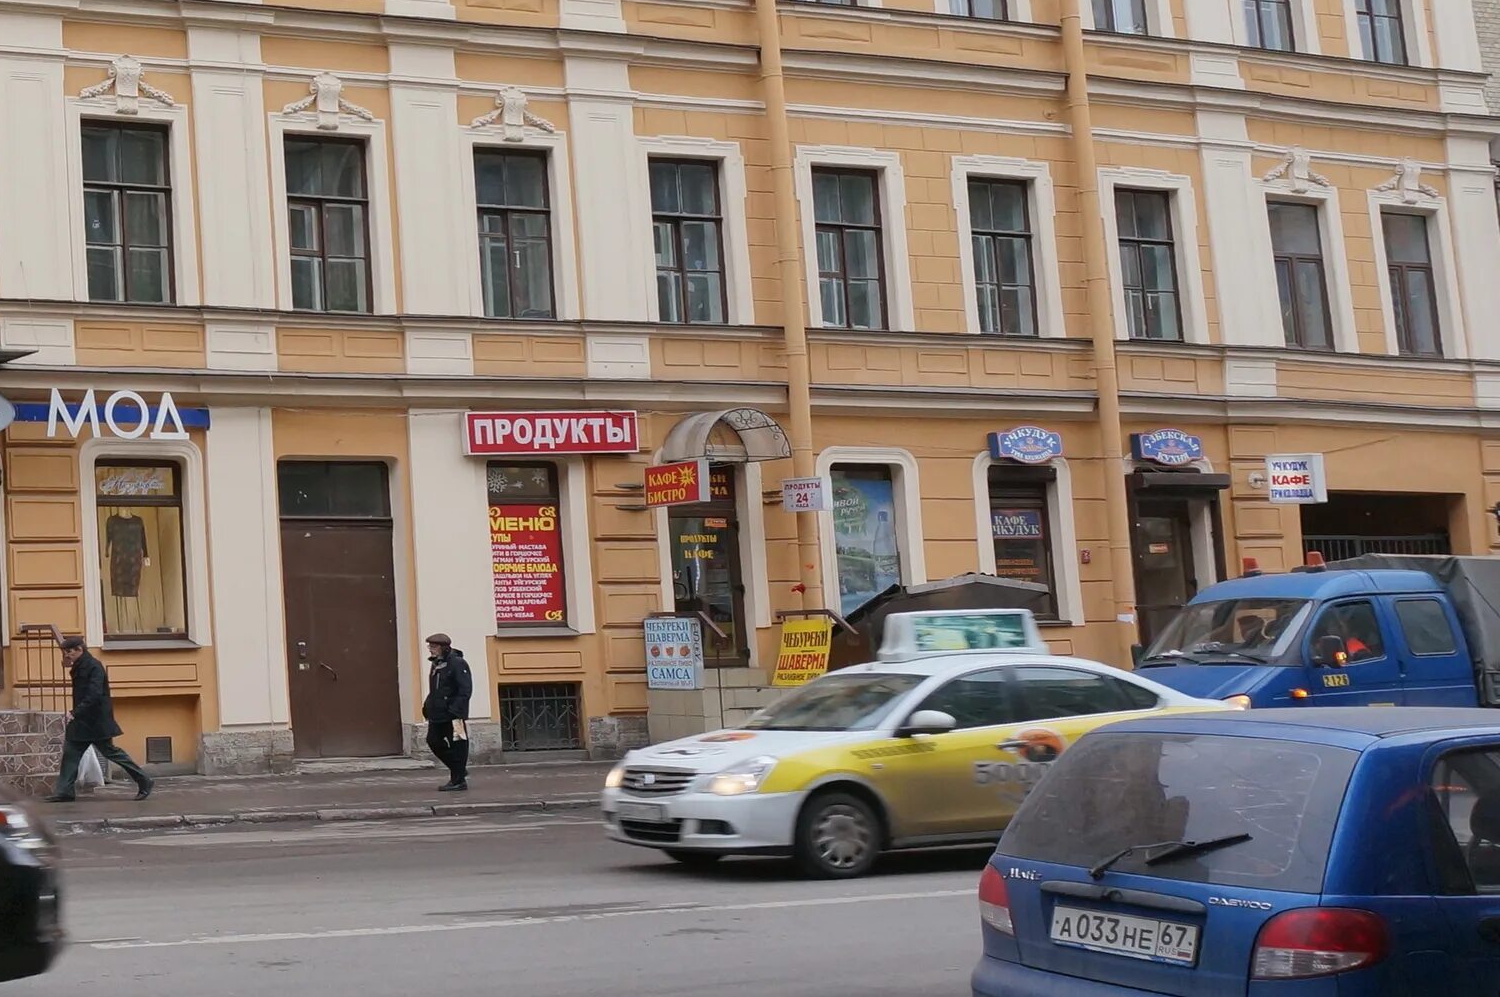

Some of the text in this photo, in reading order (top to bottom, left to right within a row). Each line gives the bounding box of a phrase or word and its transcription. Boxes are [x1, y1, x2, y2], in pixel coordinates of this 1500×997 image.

[47, 388, 190, 439] МОД
[474, 417, 631, 449] ПРОДУКТЫ
[1004, 428, 1057, 447] УЧКУДУК
[1145, 431, 1199, 452] УЗБЕКСКАЯ
[1157, 451, 1190, 463] КУХНЯ
[648, 471, 678, 487] КАФЕ
[1272, 475, 1310, 485] КАФЕ
[784, 482, 821, 490] ПРОДУКТЫ
[647, 487, 687, 504] БИСТРО
[796, 492, 809, 503] 24
[994, 515, 1028, 526] КАФЕ
[992, 525, 1040, 535] ЧКУДУК
[491, 533, 511, 542] УПЫ
[684, 549, 714, 559] КАФЕ
[494, 563, 558, 572] ОРЯЧИЕ БЛЮДА
[646, 622, 688, 631] ЧЕБУРЕКИ
[647, 633, 690, 642] ШАВЕРМА
[783, 630, 828, 648] ЧЕБУРЕКИ
[777, 653, 827, 670] ШАВЕРМА
[651, 667, 690, 679] САМСА
[1208, 897, 1272, 910] DAEWOO
[1161, 925, 1189, 947] 67
[1158, 946, 1177, 955] RUS
